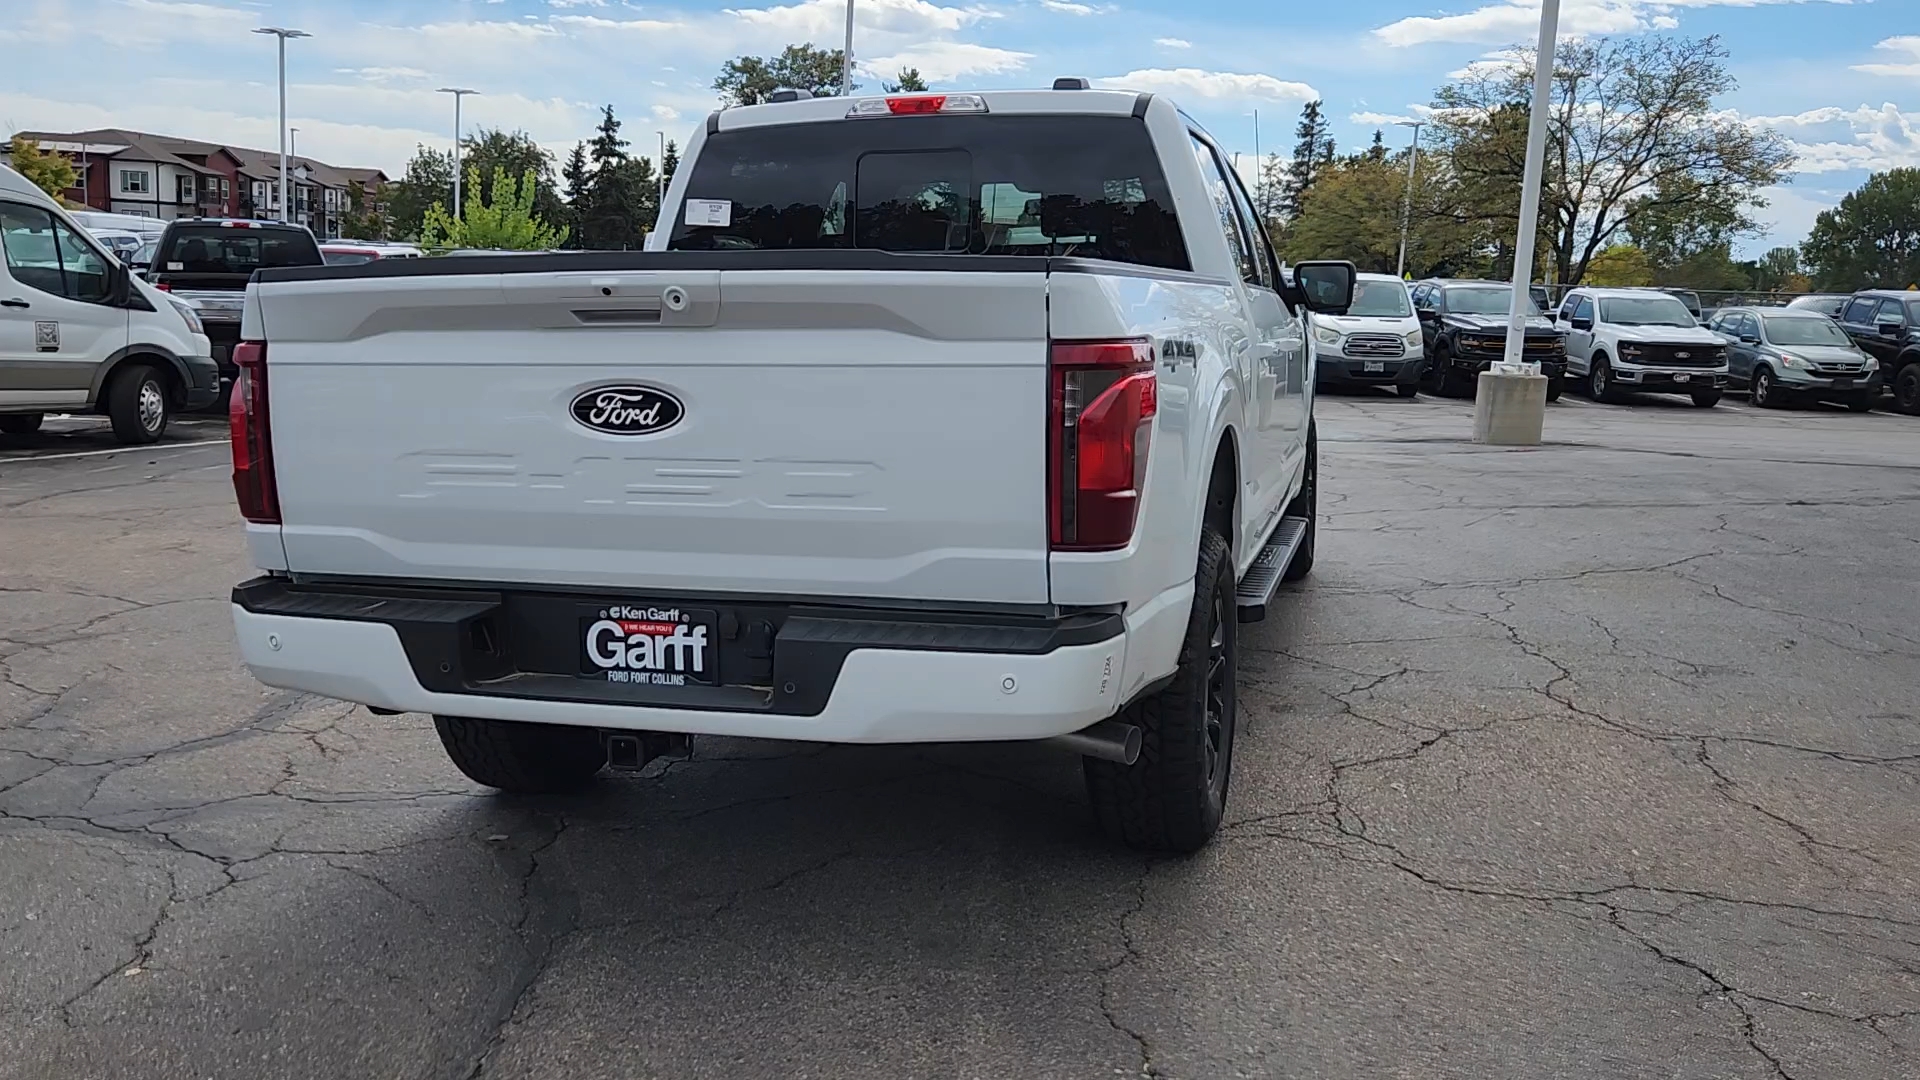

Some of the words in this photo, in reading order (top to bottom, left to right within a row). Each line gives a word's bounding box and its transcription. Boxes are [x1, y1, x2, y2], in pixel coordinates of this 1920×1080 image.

[589, 392, 662, 425] Ford
[621, 606, 647, 620] Ken
[647, 607, 680, 622] Garff
[629, 623, 639, 631] WE
[655, 624, 668, 632] YOU
[586, 619, 708, 672] Garff
[607, 670, 629, 683] FORD
[630, 672, 651, 684] FORT
[651, 673, 685, 686] COLLINS
